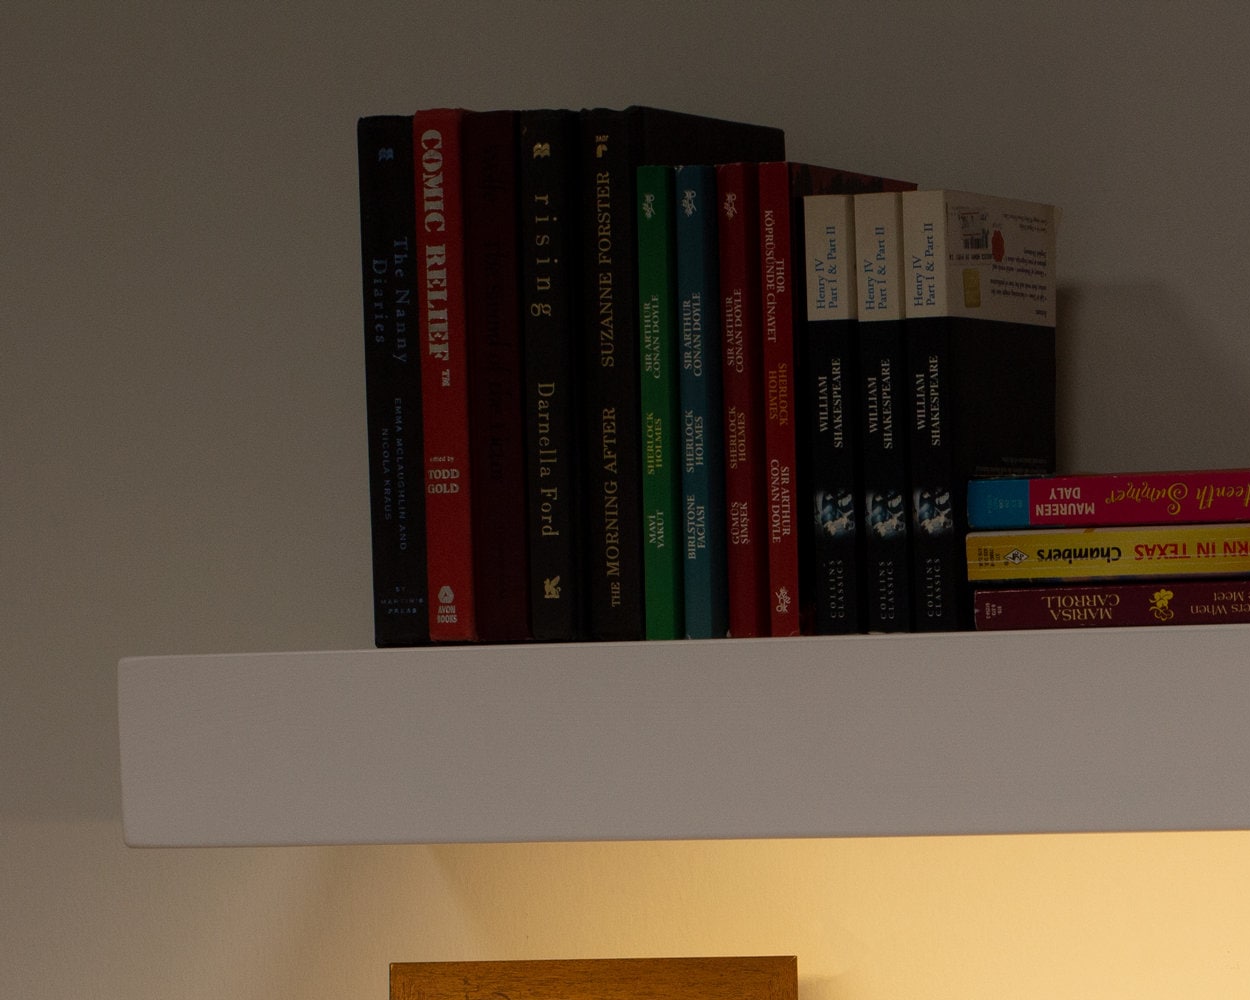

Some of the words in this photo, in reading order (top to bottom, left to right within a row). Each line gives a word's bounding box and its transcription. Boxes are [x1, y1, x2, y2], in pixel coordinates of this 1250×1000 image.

[421, 129, 446, 233] COMIC
[596, 171, 612, 266] FORSTER
[826, 226, 836, 236] II
[875, 226, 885, 236] II
[923, 222, 933, 232] II
[393, 236, 408, 279] The
[530, 194, 558, 318] rising
[764, 210, 776, 290] KÖPRÜSÜNDE
[815, 258, 825, 274] IV
[826, 240, 836, 260] Part
[876, 240, 886, 261] Part
[912, 256, 922, 270] IV
[924, 236, 934, 258] Part
[776, 258, 786, 293] THOR
[828, 265, 838, 275] &
[864, 260, 874, 274] IV
[877, 266, 887, 276] &
[925, 262, 935, 272] &
[372, 258, 388, 345] Diaries
[425, 243, 450, 361] RELIEF
[816, 276, 827, 310] Henry
[828, 287, 838, 310] Part
[866, 276, 877, 310] Henry
[878, 288, 888, 310] Part
[914, 273, 925, 306] Henry
[926, 285, 936, 306] Part
[393, 288, 411, 363] Nanny
[600, 272, 614, 368] SUZANNE
[644, 302, 652, 350] ARTHUR
[651, 295, 660, 338] DOYLE
[682, 300, 692, 350] ARTHUR
[692, 292, 701, 336] DOYLE
[726, 296, 734, 346] ARTHUR
[734, 288, 743, 334] DOYLE
[644, 352, 652, 372] SIR
[652, 340, 660, 379] CONAN
[684, 352, 692, 370] SIR
[693, 338, 702, 376] CONAN
[727, 349, 735, 366] SIR
[735, 335, 744, 374] CONAN
[768, 370, 778, 420] HOLMES
[778, 362, 788, 426] SHERLOCK
[818, 376, 828, 432] WILLIAM
[832, 357, 844, 449] SHAKESPEARE
[868, 376, 878, 434] WILLIAM
[881, 358, 893, 450] SHAKESPEARE
[916, 372, 926, 431] WILLIAM
[929, 355, 942, 447] SHAKESPEARE
[537, 382, 558, 478] Darnella
[602, 407, 616, 475] AFTER
[646, 412, 654, 476] SHERLOCK
[684, 409, 694, 472] SHERLOCK
[694, 416, 704, 466] HOLMES
[728, 406, 738, 470] SHERLOCK
[738, 412, 746, 462] HOLMES
[382, 428, 392, 474] NICOLA
[394, 398, 404, 433] EMMA
[399, 524, 408, 551] AND
[428, 468, 460, 480] TODD
[428, 483, 460, 494] GOLD
[770, 458, 780, 497] CONAN
[781, 466, 790, 484] SIR
[1050, 487, 1081, 500] DALY
[384, 480, 394, 522] KRAUS
[540, 488, 560, 536] Ford
[782, 486, 791, 536] ARTHUR
[1036, 502, 1096, 516] MAUREEN
[1105, 481, 1190, 516] Summer
[604, 480, 620, 578] MORNING
[656, 510, 665, 549] YAKUT
[686, 494, 696, 560] BIRLSTONE
[771, 499, 782, 544] DOYLE
[1037, 546, 1122, 564] Chambers
[1134, 543, 1192, 561] TEXAS
[1197, 542, 1216, 558] IN
[610, 582, 621, 608] THE
[829, 560, 837, 618] COLLINS
[887, 560, 895, 620] CLASSICS
[934, 558, 942, 618] CLASSICS
[1041, 594, 1120, 608] CARROLL
[1214, 592, 1244, 600] Meet
[436, 614, 458, 624] BOOKS
[438, 606, 456, 614] AVON
[1050, 608, 1113, 620] MARISA
[1190, 602, 1228, 616] When
